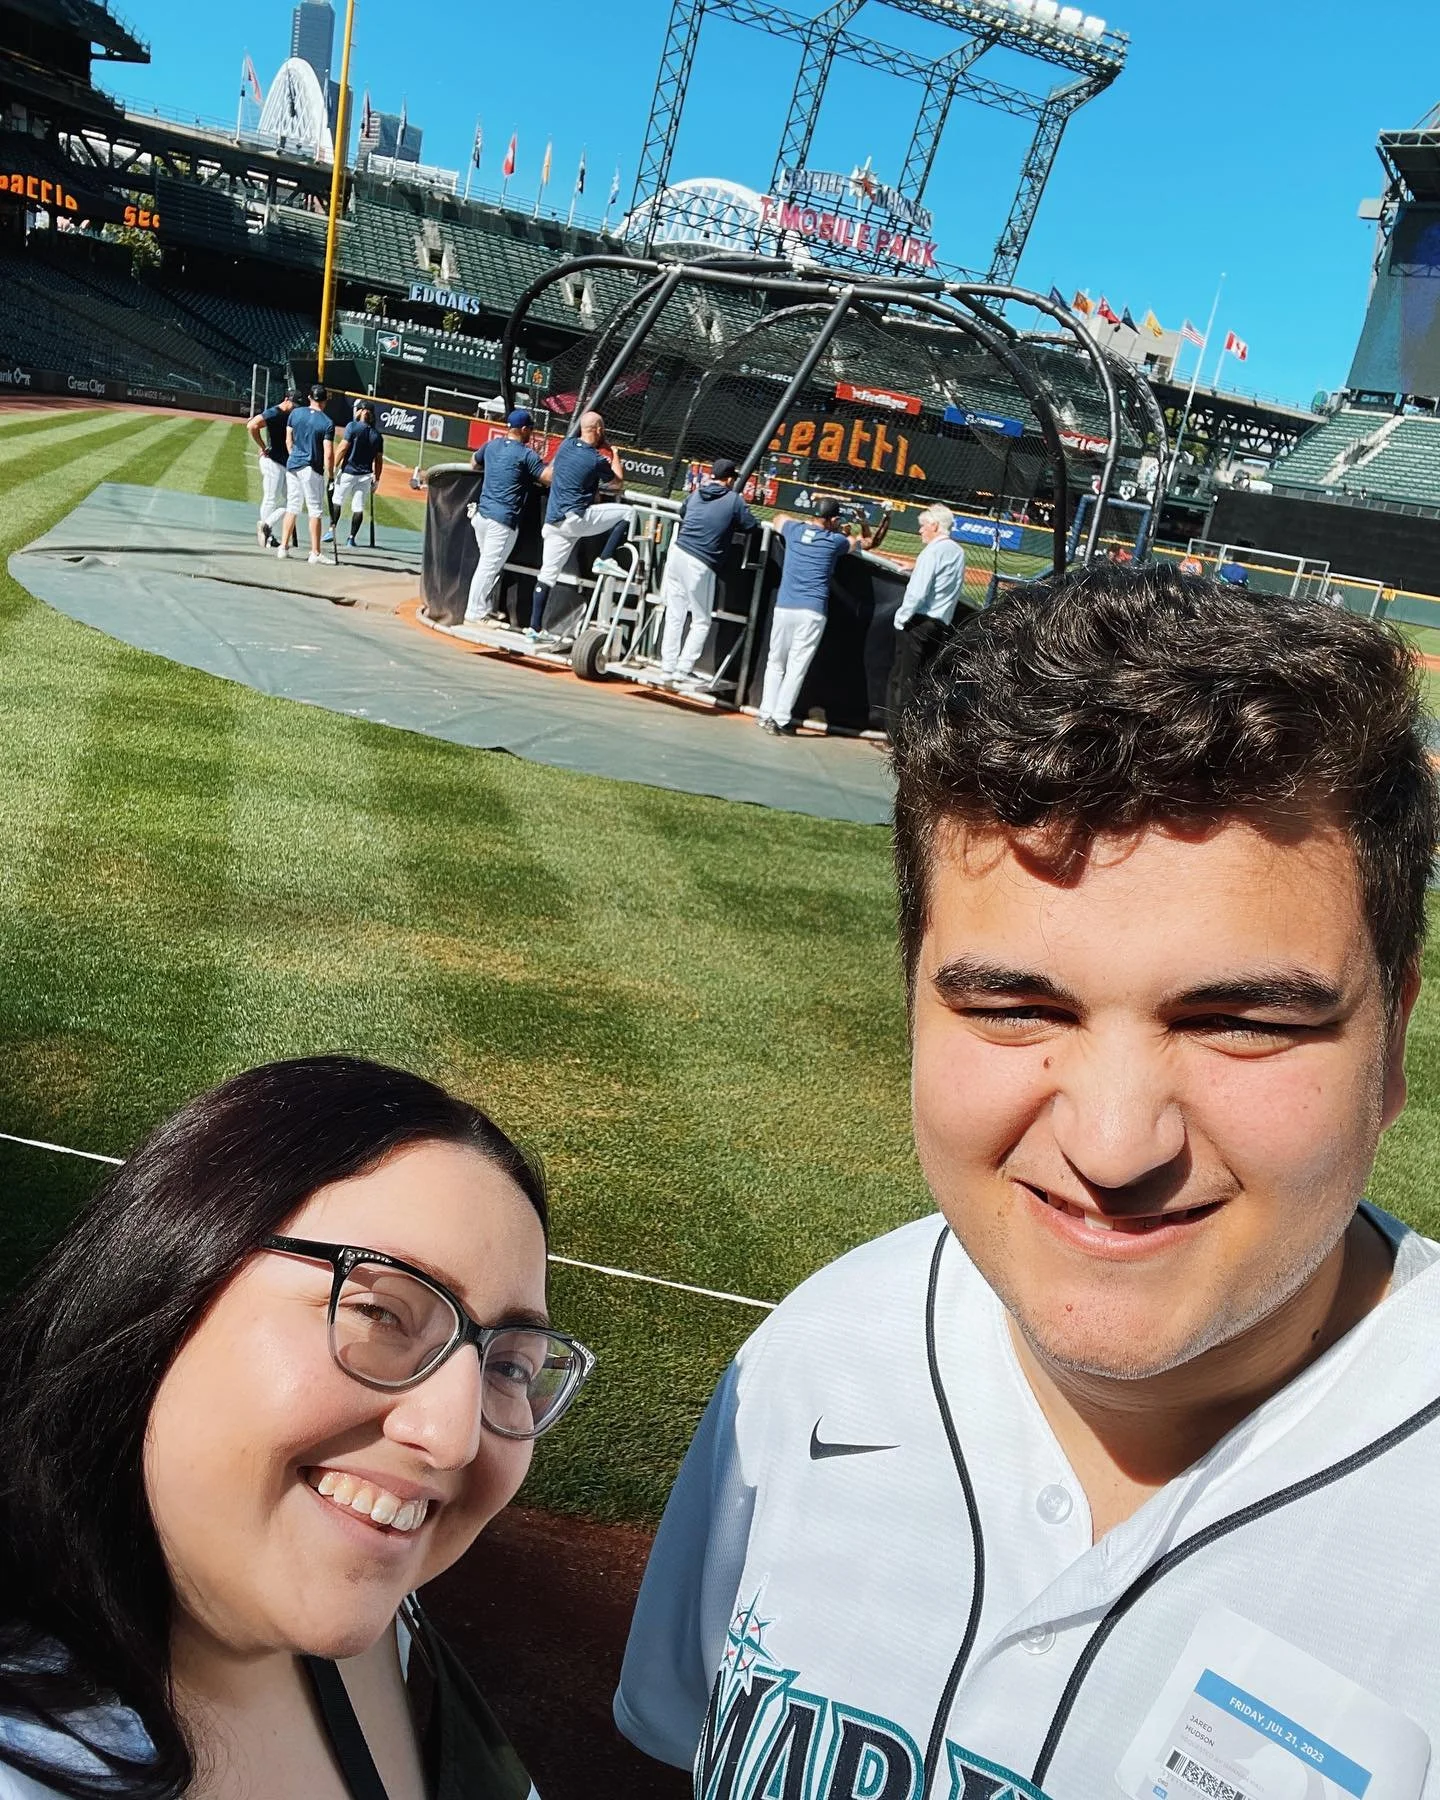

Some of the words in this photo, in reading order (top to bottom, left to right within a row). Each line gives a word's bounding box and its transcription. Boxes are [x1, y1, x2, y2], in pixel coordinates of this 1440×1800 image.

[760, 196, 871, 251] T-MOBILE
[875, 225, 938, 270] PARK
[68, 375, 89, 391] Great
[89, 379, 106, 397] Clips
[1189, 1715, 1213, 1733] JARED
[1228, 1696, 1265, 1727] FRIDAY,
[1265, 1720, 1283, 1737] JUL
[1284, 1732, 1298, 1748] 21,
[1300, 1742, 1325, 1764] 2023
[1185, 1725, 1215, 1747] HUDSON
